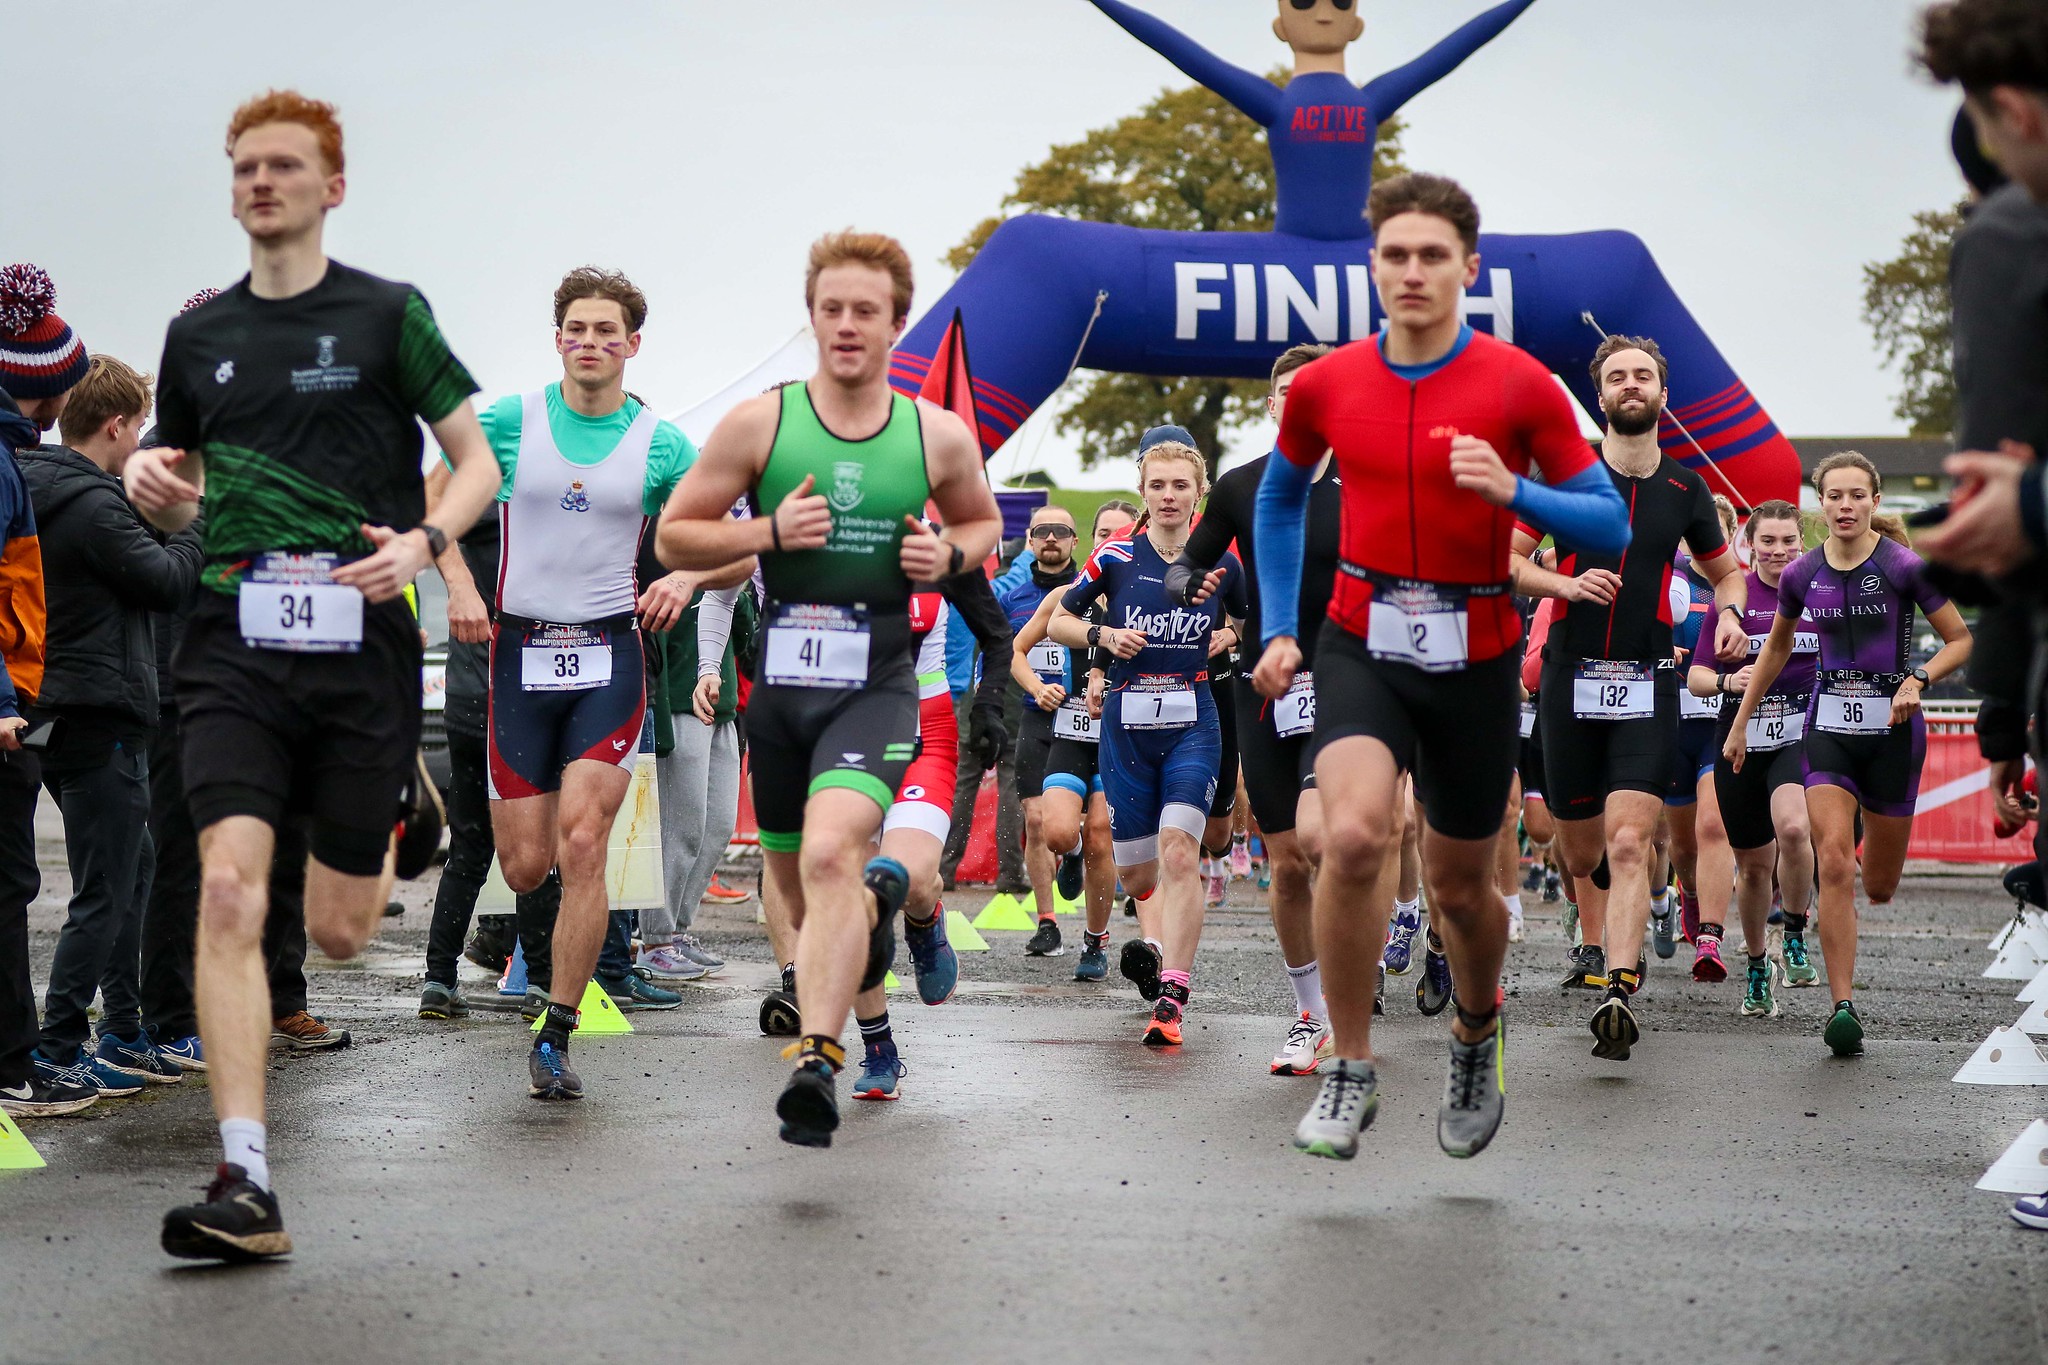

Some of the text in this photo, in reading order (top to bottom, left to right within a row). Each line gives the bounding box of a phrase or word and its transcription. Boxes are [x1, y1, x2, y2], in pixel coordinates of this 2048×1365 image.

[1290, 105, 1367, 131] ACTIVE
[1174, 262, 1514, 342] FINIH
[281, 594, 313, 629] 34
[1813, 604, 1888, 618] DUR HAM
[910, 620, 925, 628] lub
[799, 637, 822, 668] 41
[1750, 637, 1819, 650] DAM
[554, 653, 580, 678] 33
[1046, 650, 1059, 666] 15
[1600, 685, 1628, 707] 132
[1153, 698, 1162, 718] 7
[1843, 701, 1863, 723] 36
[1073, 713, 1090, 732] 58
[1766, 721, 1784, 741] 42
